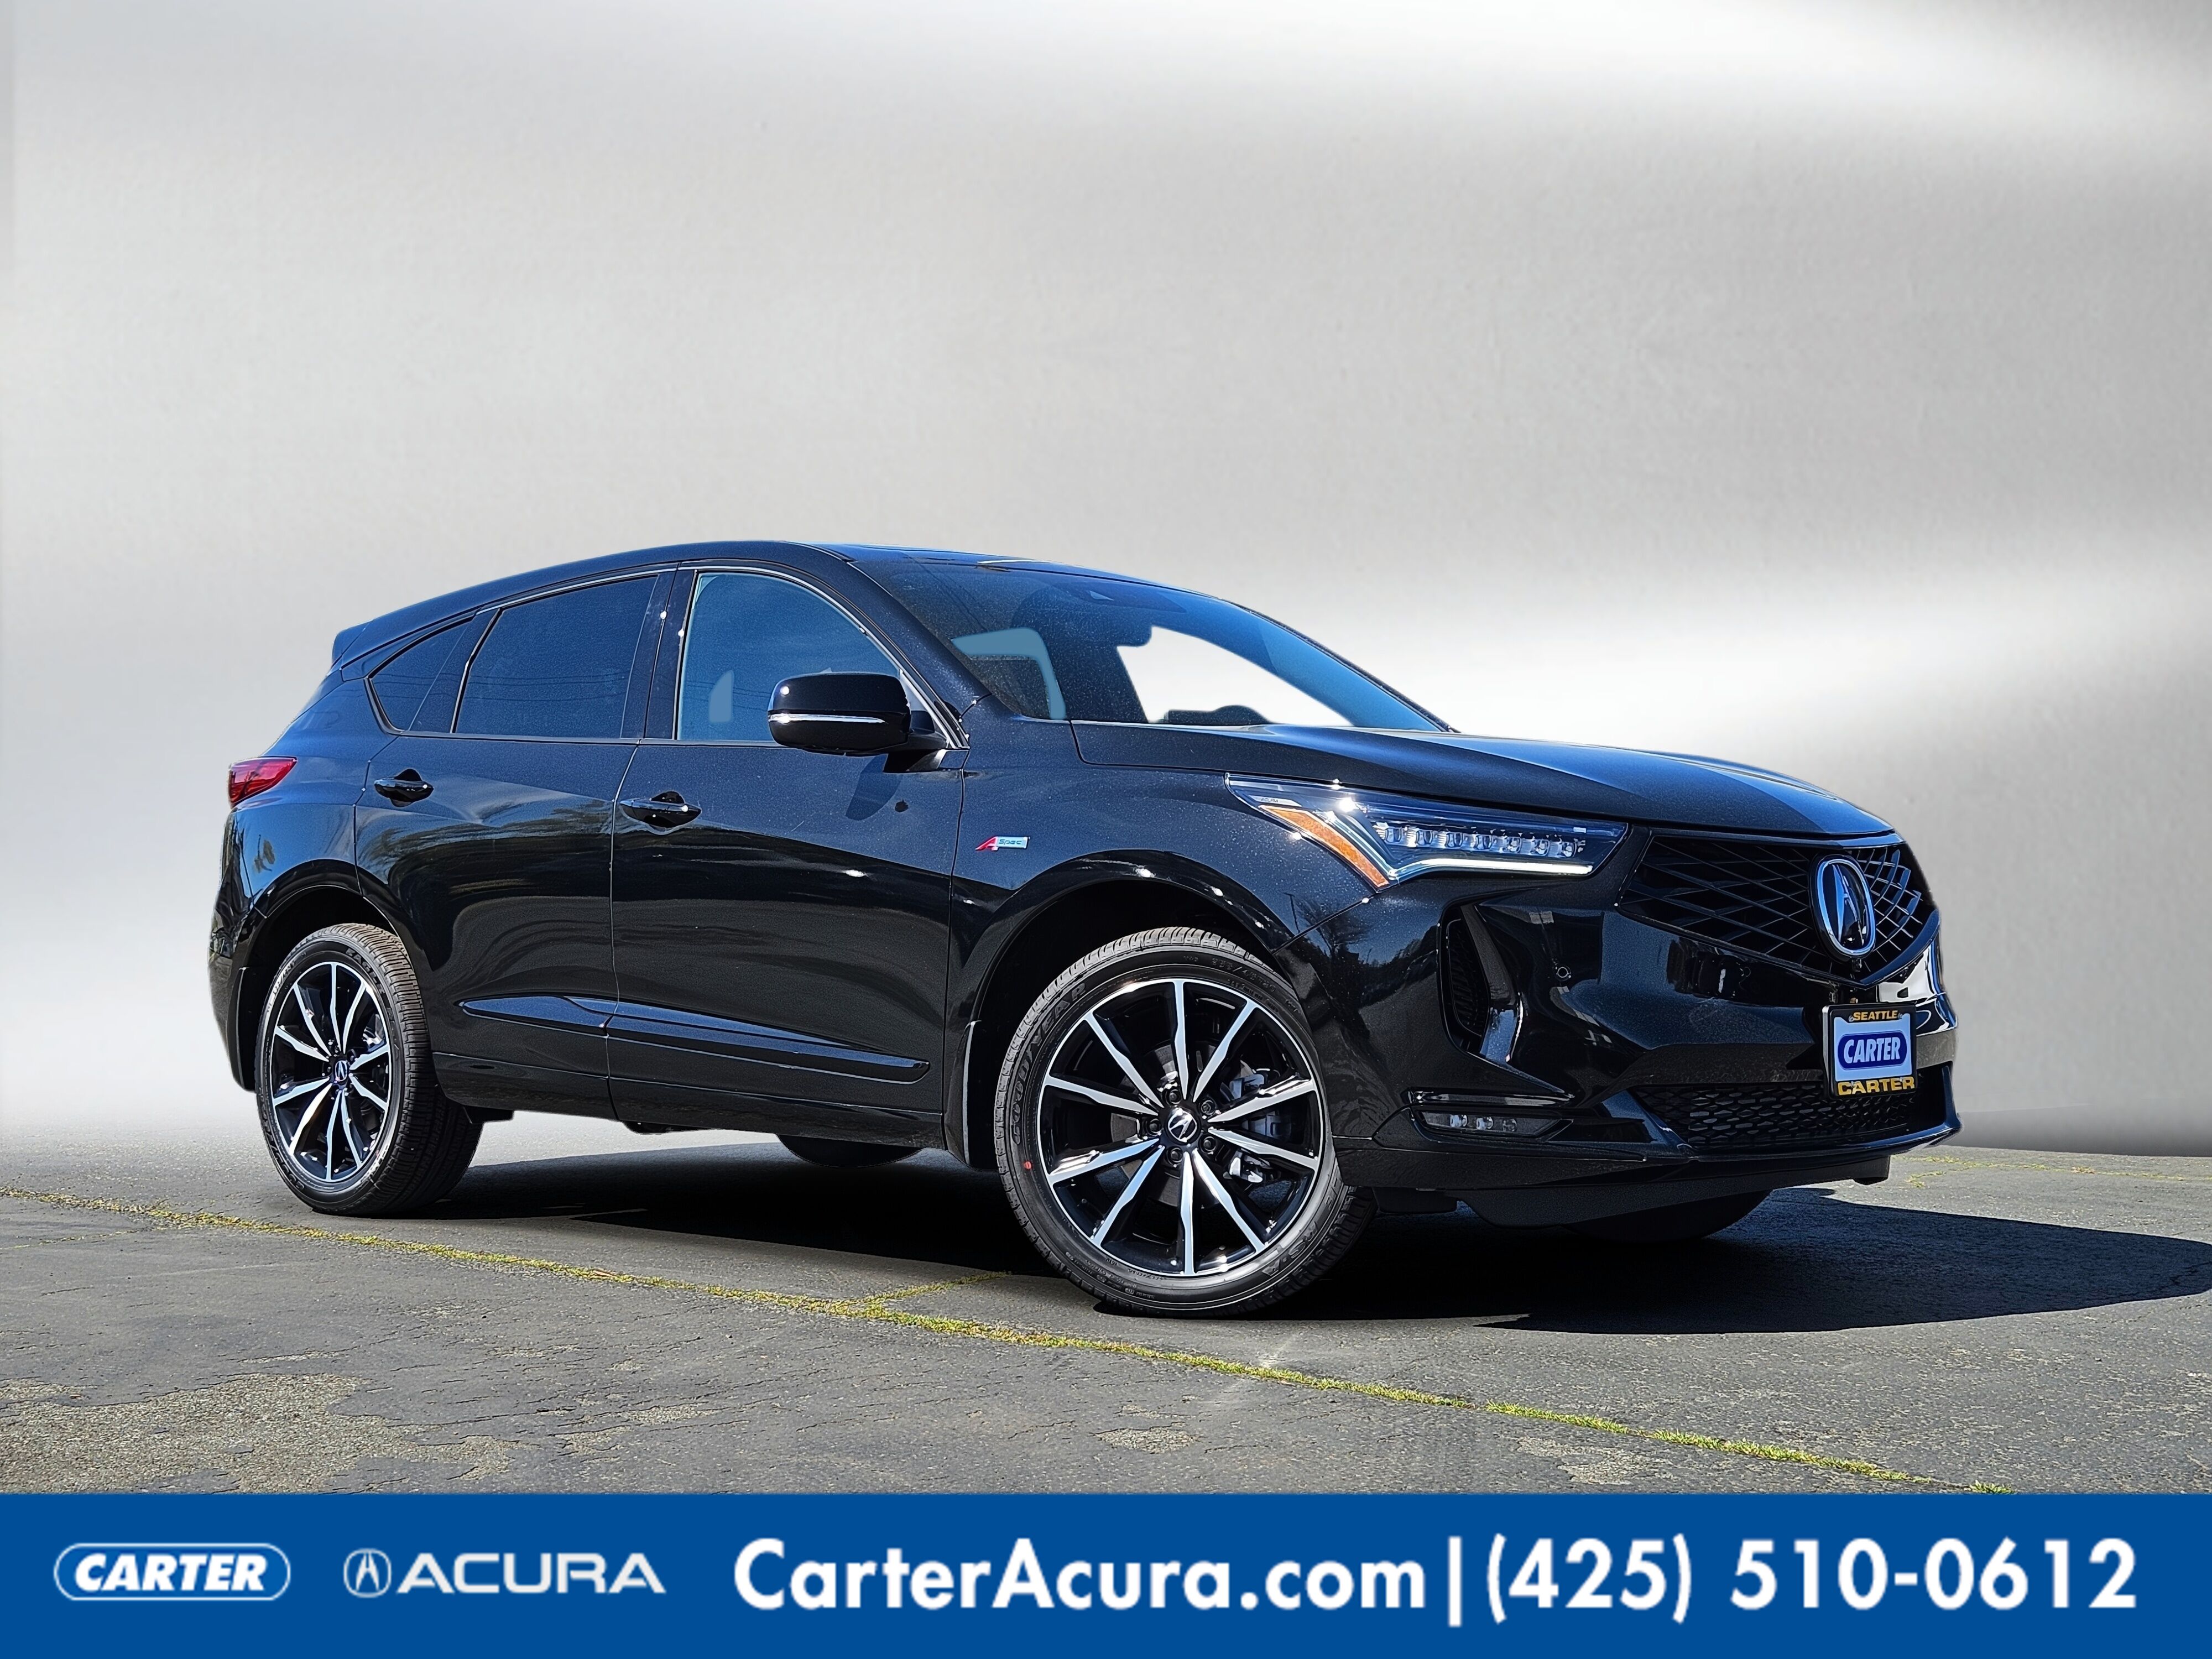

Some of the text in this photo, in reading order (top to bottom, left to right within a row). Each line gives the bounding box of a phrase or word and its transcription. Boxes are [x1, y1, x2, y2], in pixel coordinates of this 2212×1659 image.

[1853, 1010, 1898, 1021] SEATTLE
[1843, 1036, 1901, 1064] CARTER
[1010, 982, 1087, 1145] GOODYEAR
[1837, 1076, 1915, 1096] CARTER
